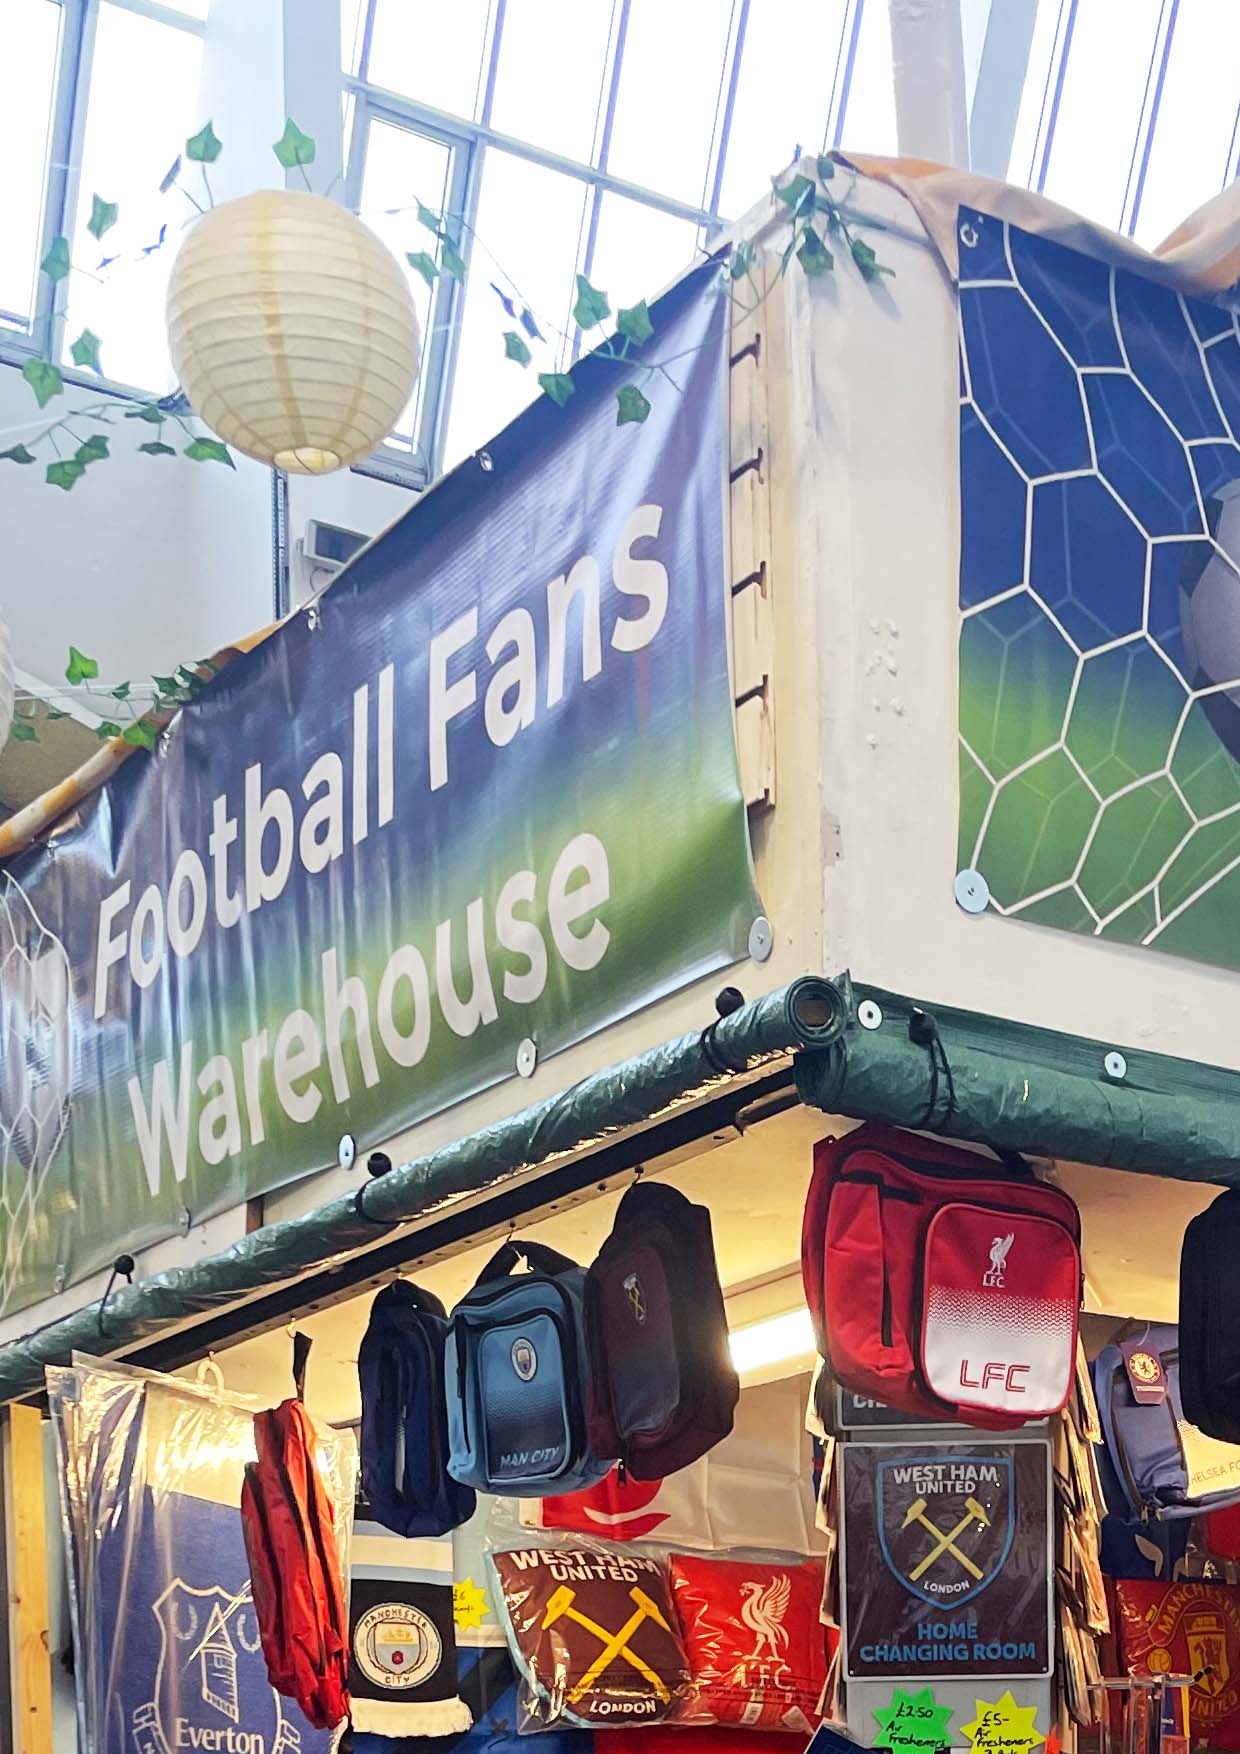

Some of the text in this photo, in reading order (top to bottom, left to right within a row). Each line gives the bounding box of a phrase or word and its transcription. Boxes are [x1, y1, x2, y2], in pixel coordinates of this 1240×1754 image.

[95, 504, 670, 1020] Football Fans
[127, 833, 611, 1198] Warehouse
[982, 1273, 1006, 1289] LFC
[959, 1359, 1032, 1392] LFC
[893, 1465, 998, 1484] WEST HAM
[1190, 1466, 1227, 1484] HELSEA
[915, 1481, 976, 1494] UNITED
[510, 1549, 662, 1576] WEST HAM
[550, 1564, 638, 1583] UNITED
[923, 1580, 970, 1593] LONDON
[363, 1608, 427, 1629] MANCHESTER
[917, 1623, 977, 1641] HOME
[859, 1642, 1036, 1662] CHANGING ROOM
[384, 1676, 410, 1684] CITY
[589, 1699, 657, 1715] LONDON
[886, 1721, 902, 1732] Air
[974, 1728, 992, 1738] Air
[976, 1736, 1034, 1748] Fresheners
